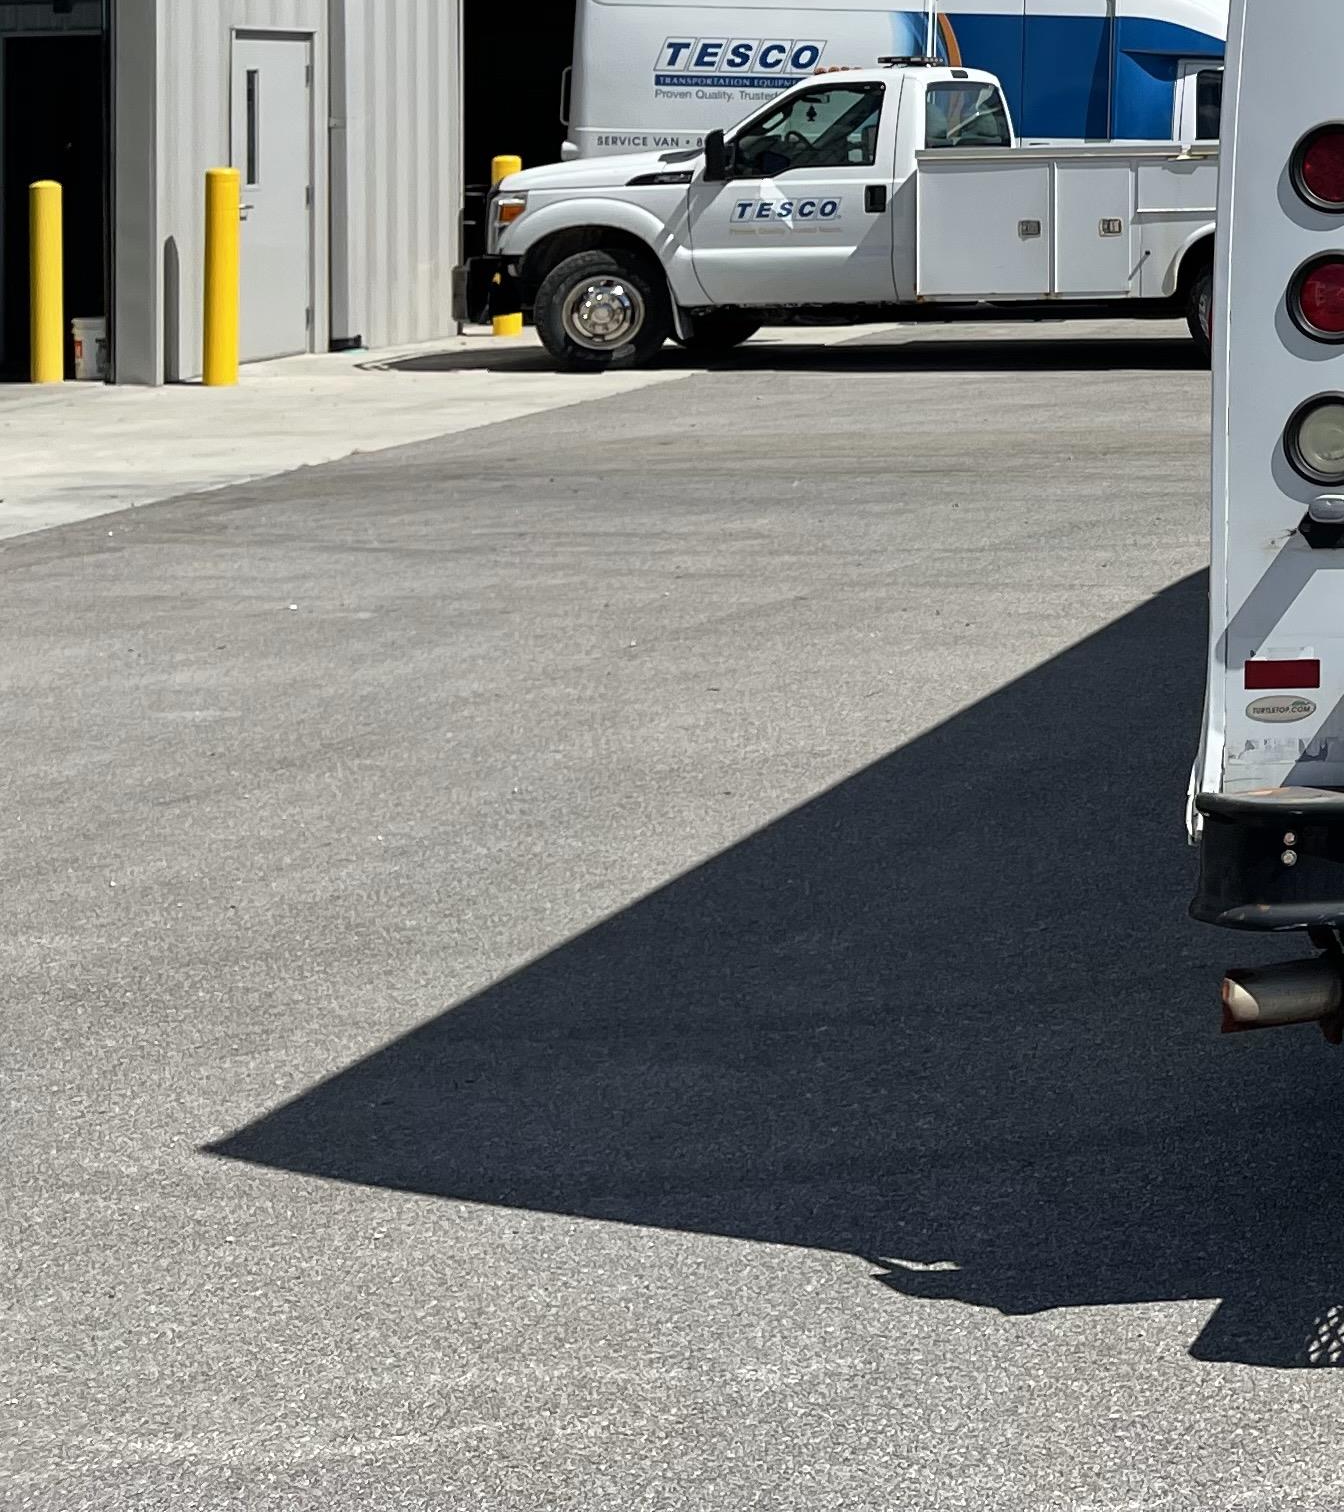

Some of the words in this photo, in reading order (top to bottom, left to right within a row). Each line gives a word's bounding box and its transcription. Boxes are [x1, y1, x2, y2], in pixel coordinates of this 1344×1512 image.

[666, 42, 820, 70] TESCO
[659, 76, 750, 87] TRANSPORTATION
[654, 89, 692, 99] Proven
[695, 89, 735, 103] Quality.
[597, 135, 648, 147] SERVICE
[653, 136, 680, 147] VAN
[737, 200, 838, 219] TESCO
